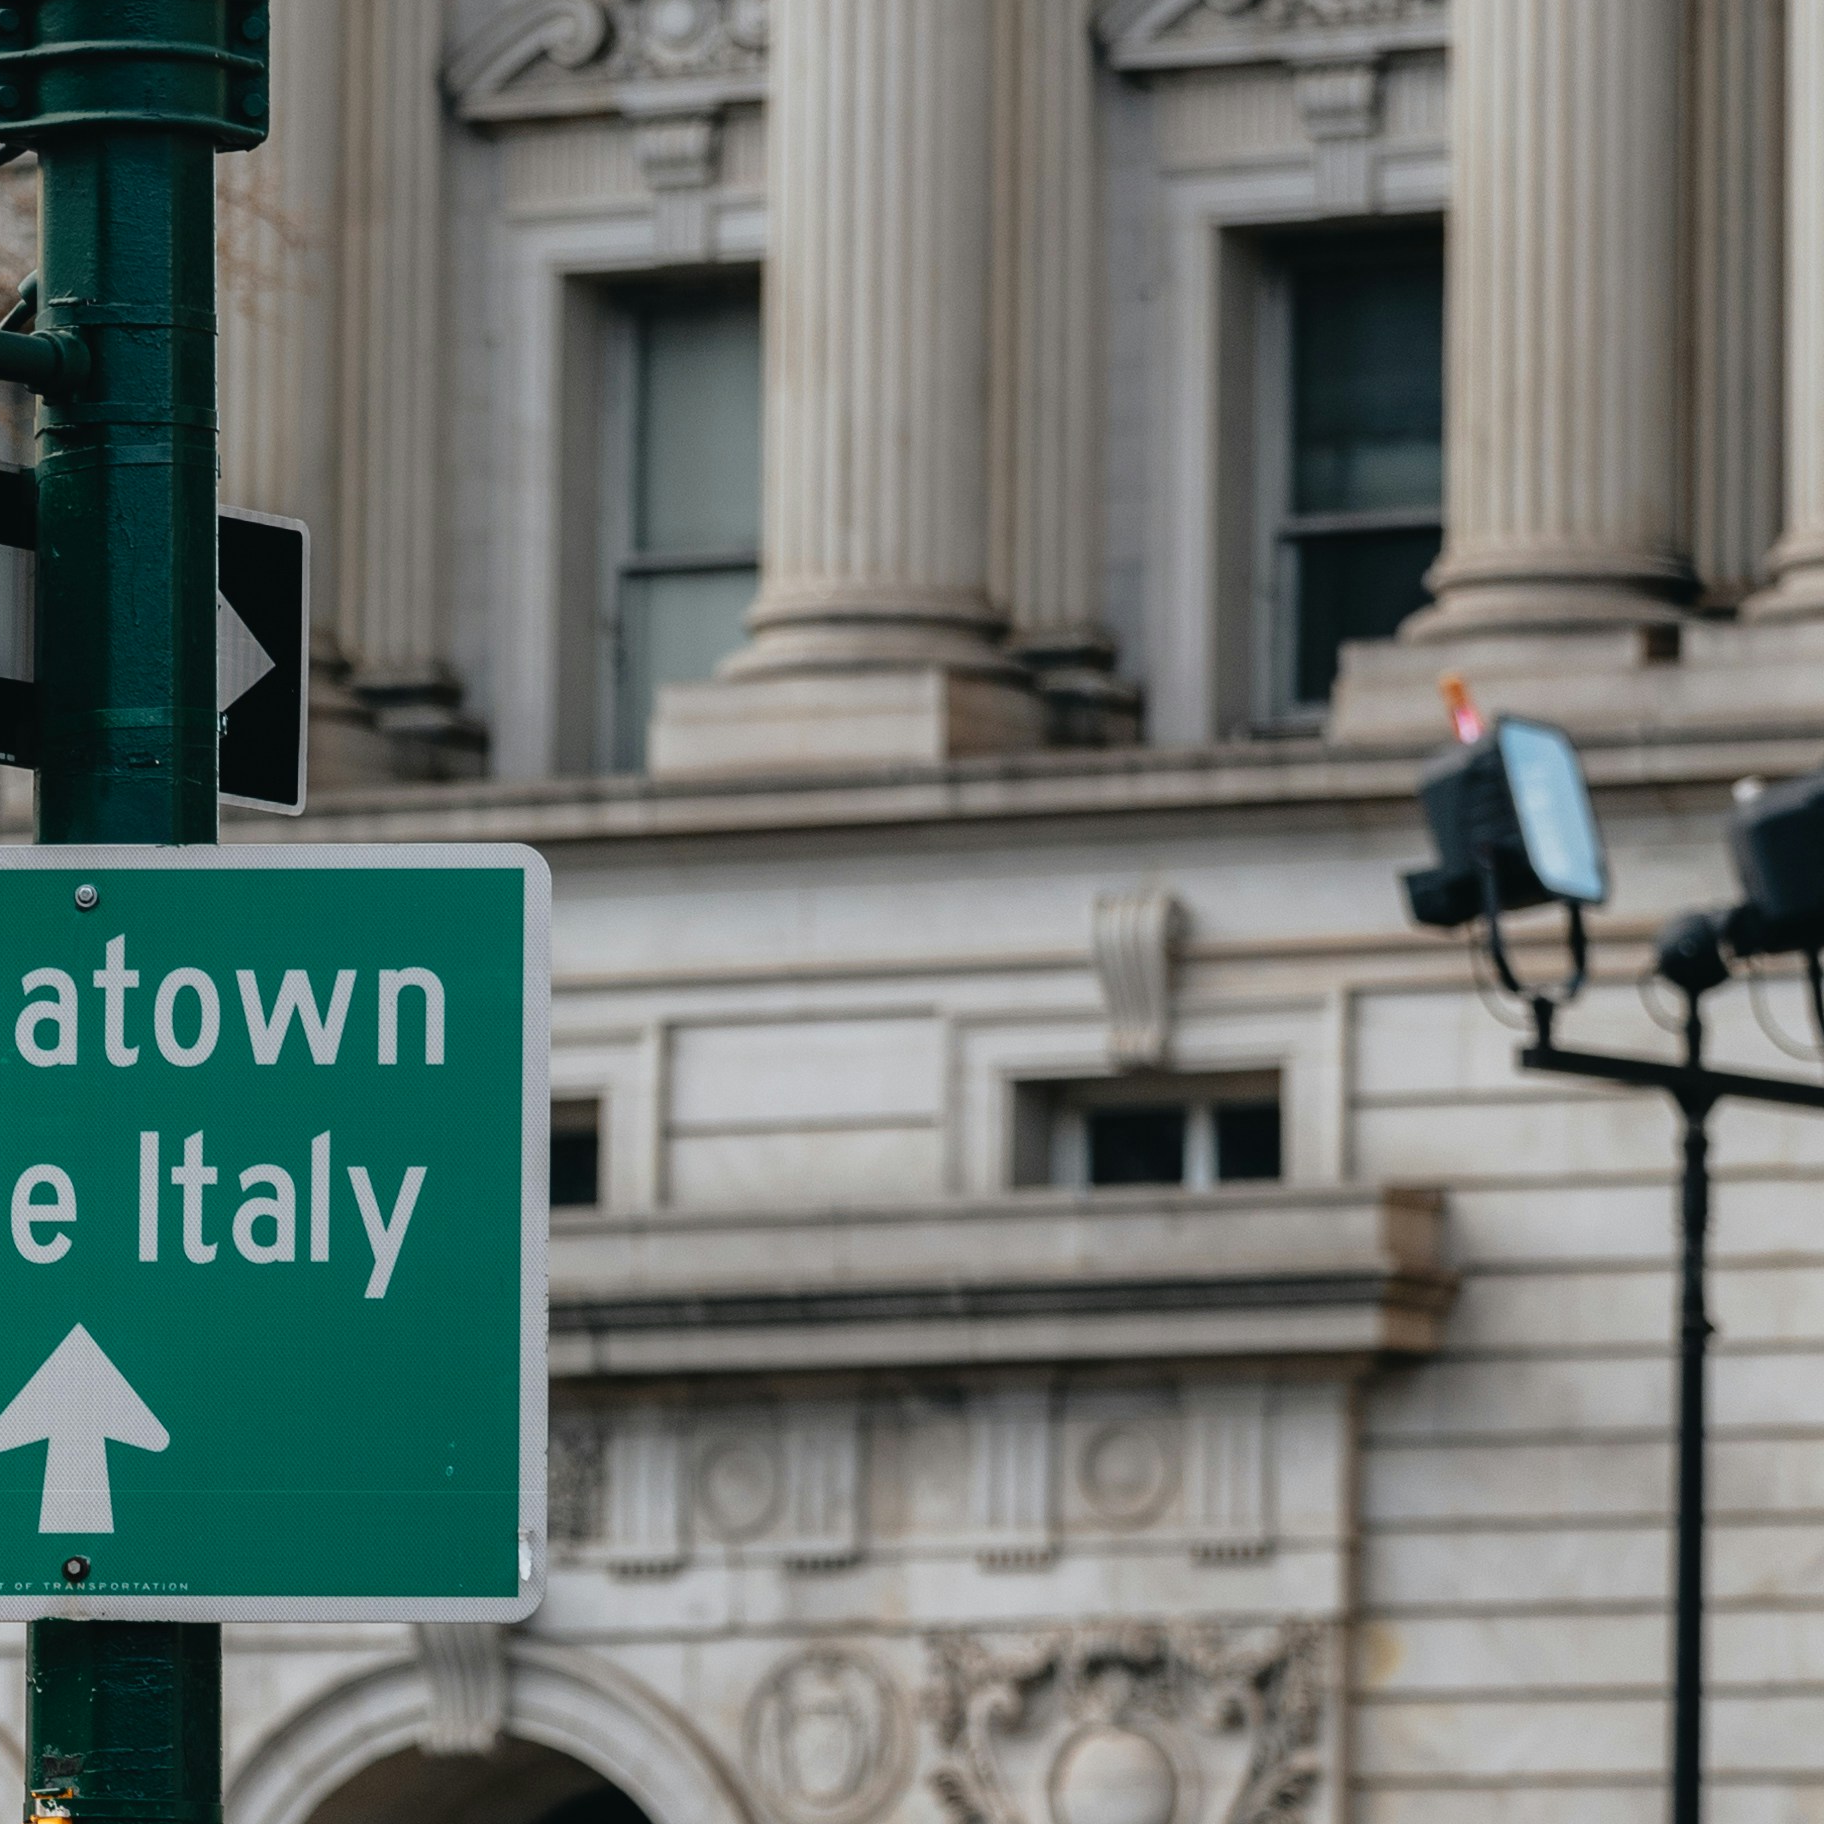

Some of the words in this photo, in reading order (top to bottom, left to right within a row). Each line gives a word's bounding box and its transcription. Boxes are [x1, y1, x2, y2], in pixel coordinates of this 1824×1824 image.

[138, 1128, 428, 1301] Italy
[14, 1582, 33, 1591] OF
[43, 1582, 190, 1592] TRANSPORTATION
